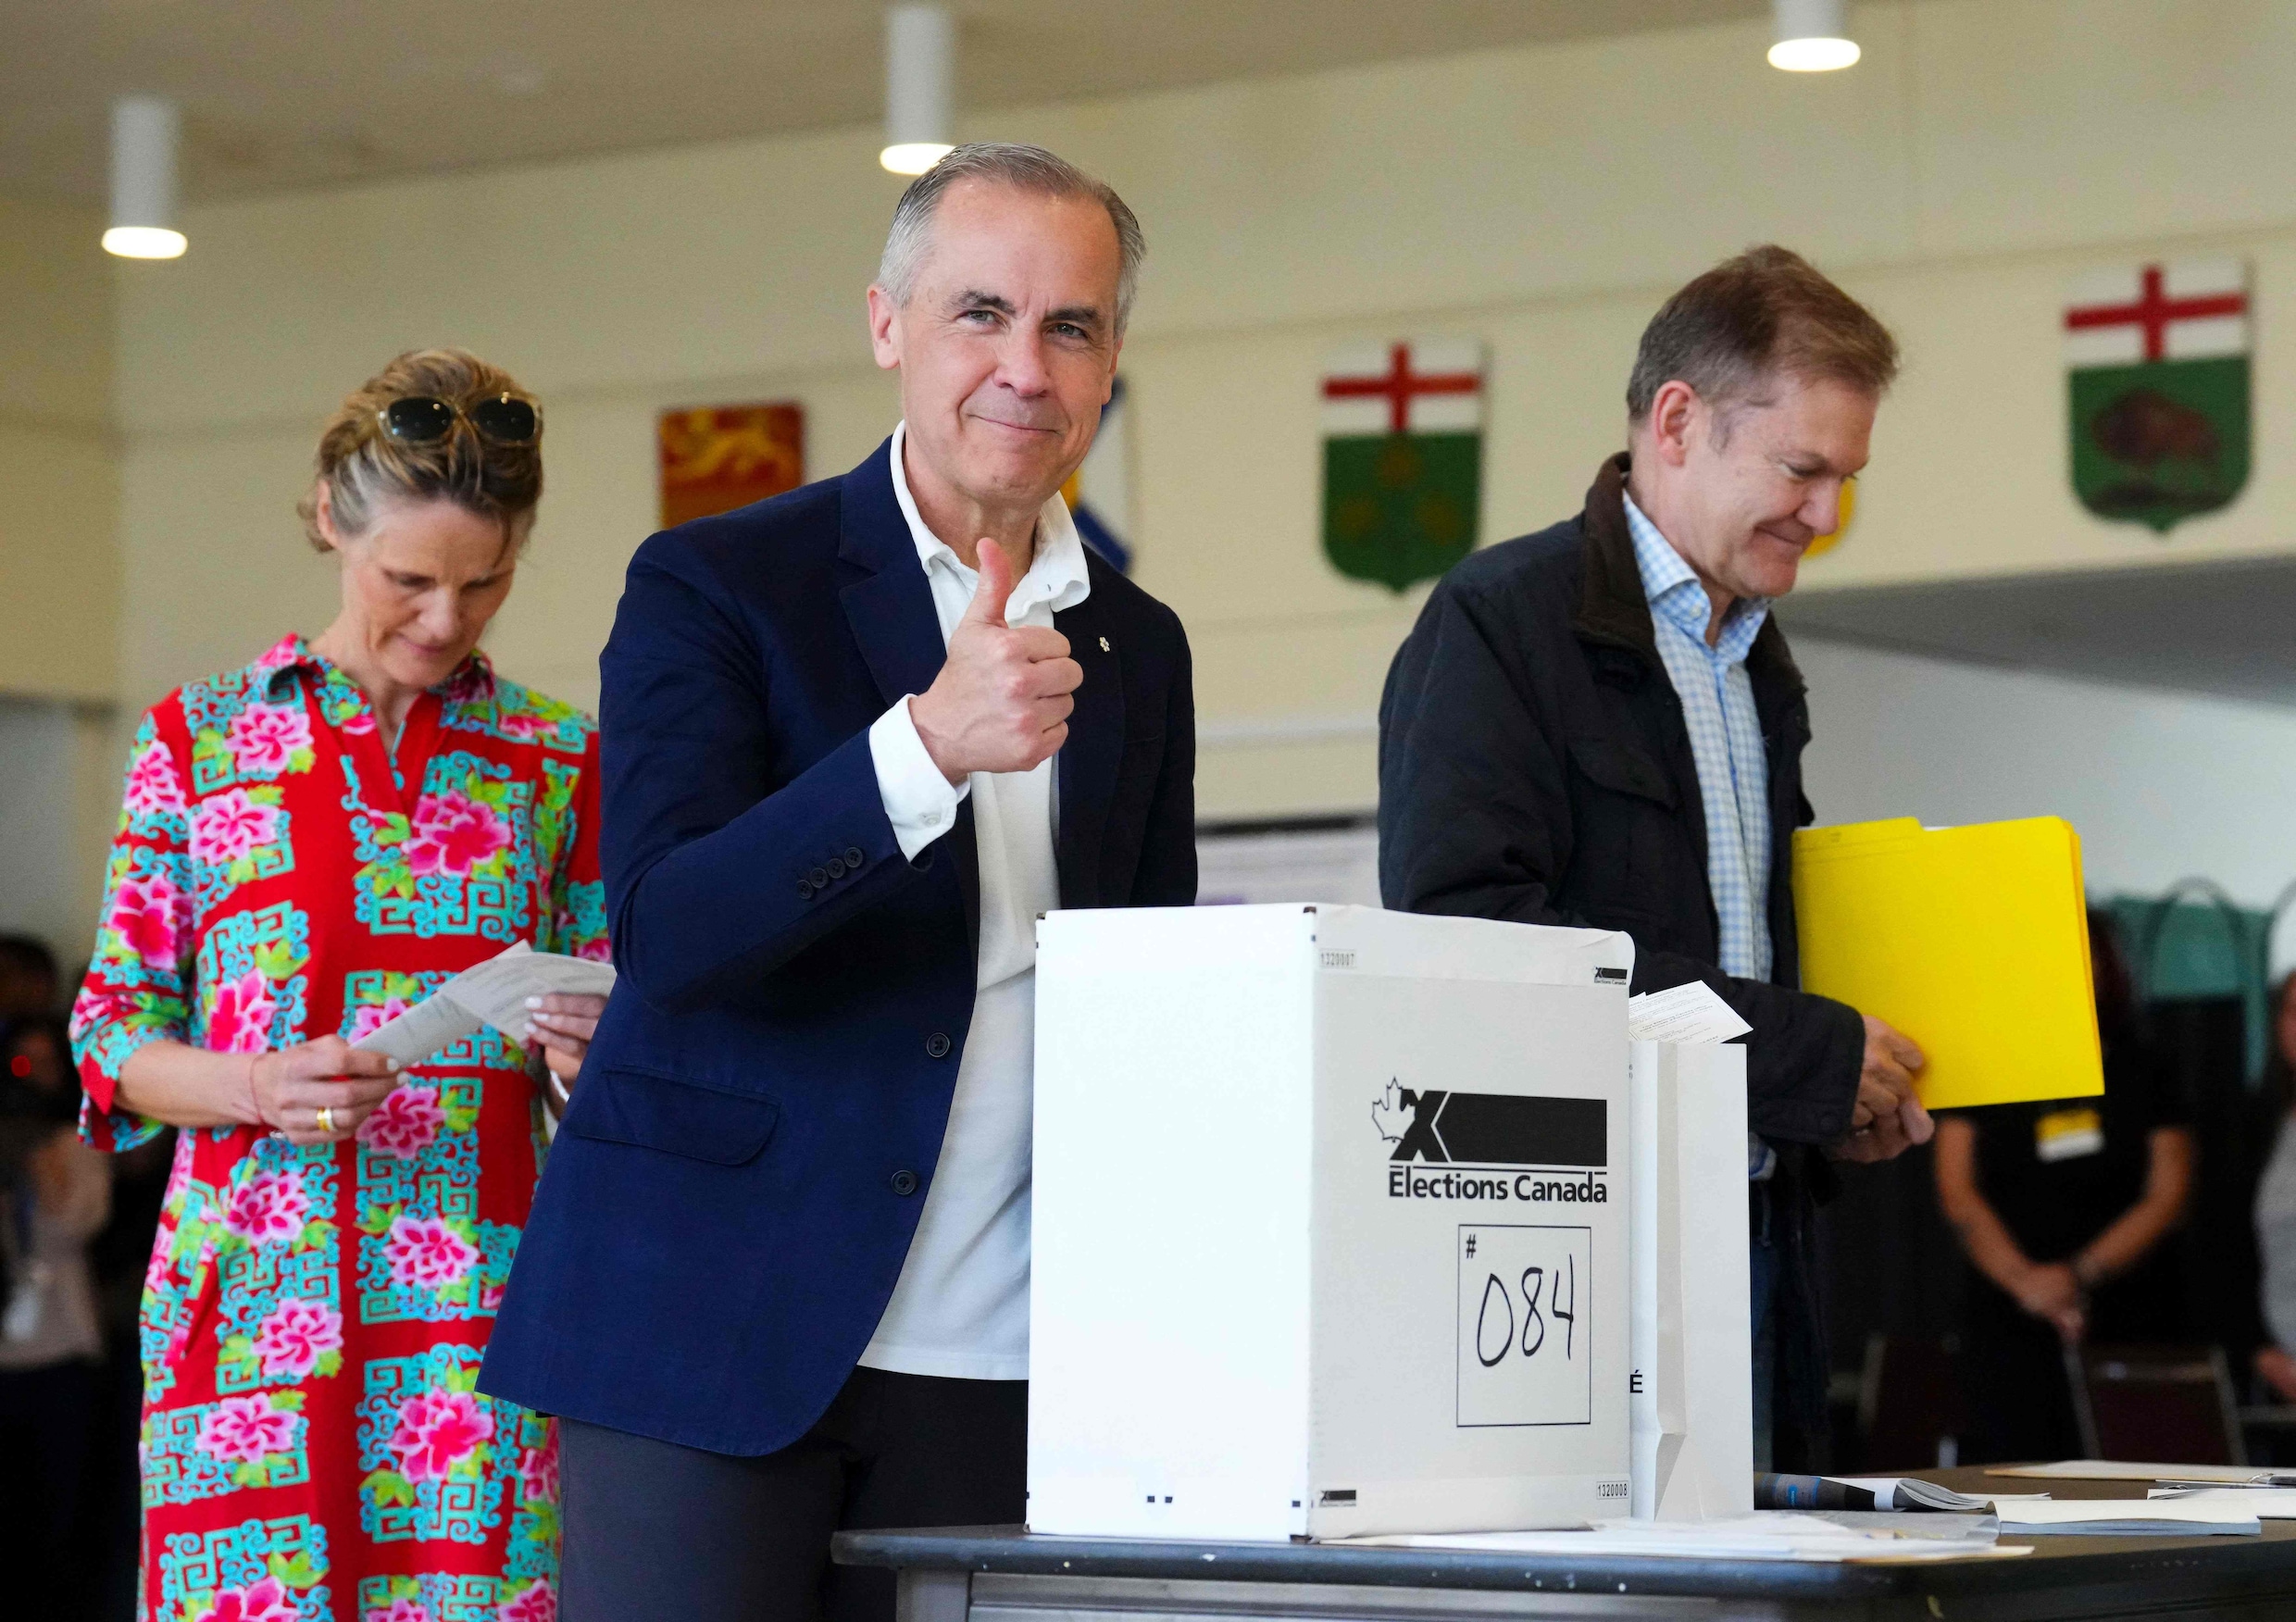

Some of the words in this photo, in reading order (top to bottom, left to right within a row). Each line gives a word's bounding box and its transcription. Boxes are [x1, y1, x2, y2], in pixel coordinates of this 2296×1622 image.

[1389, 1166, 1509, 1201] Elections
[1514, 1171, 1607, 1204] Canada
[1466, 1234, 1477, 1259] #
[1477, 1253, 1574, 1367] 084
[1598, 1483, 1628, 1497] 1320008
